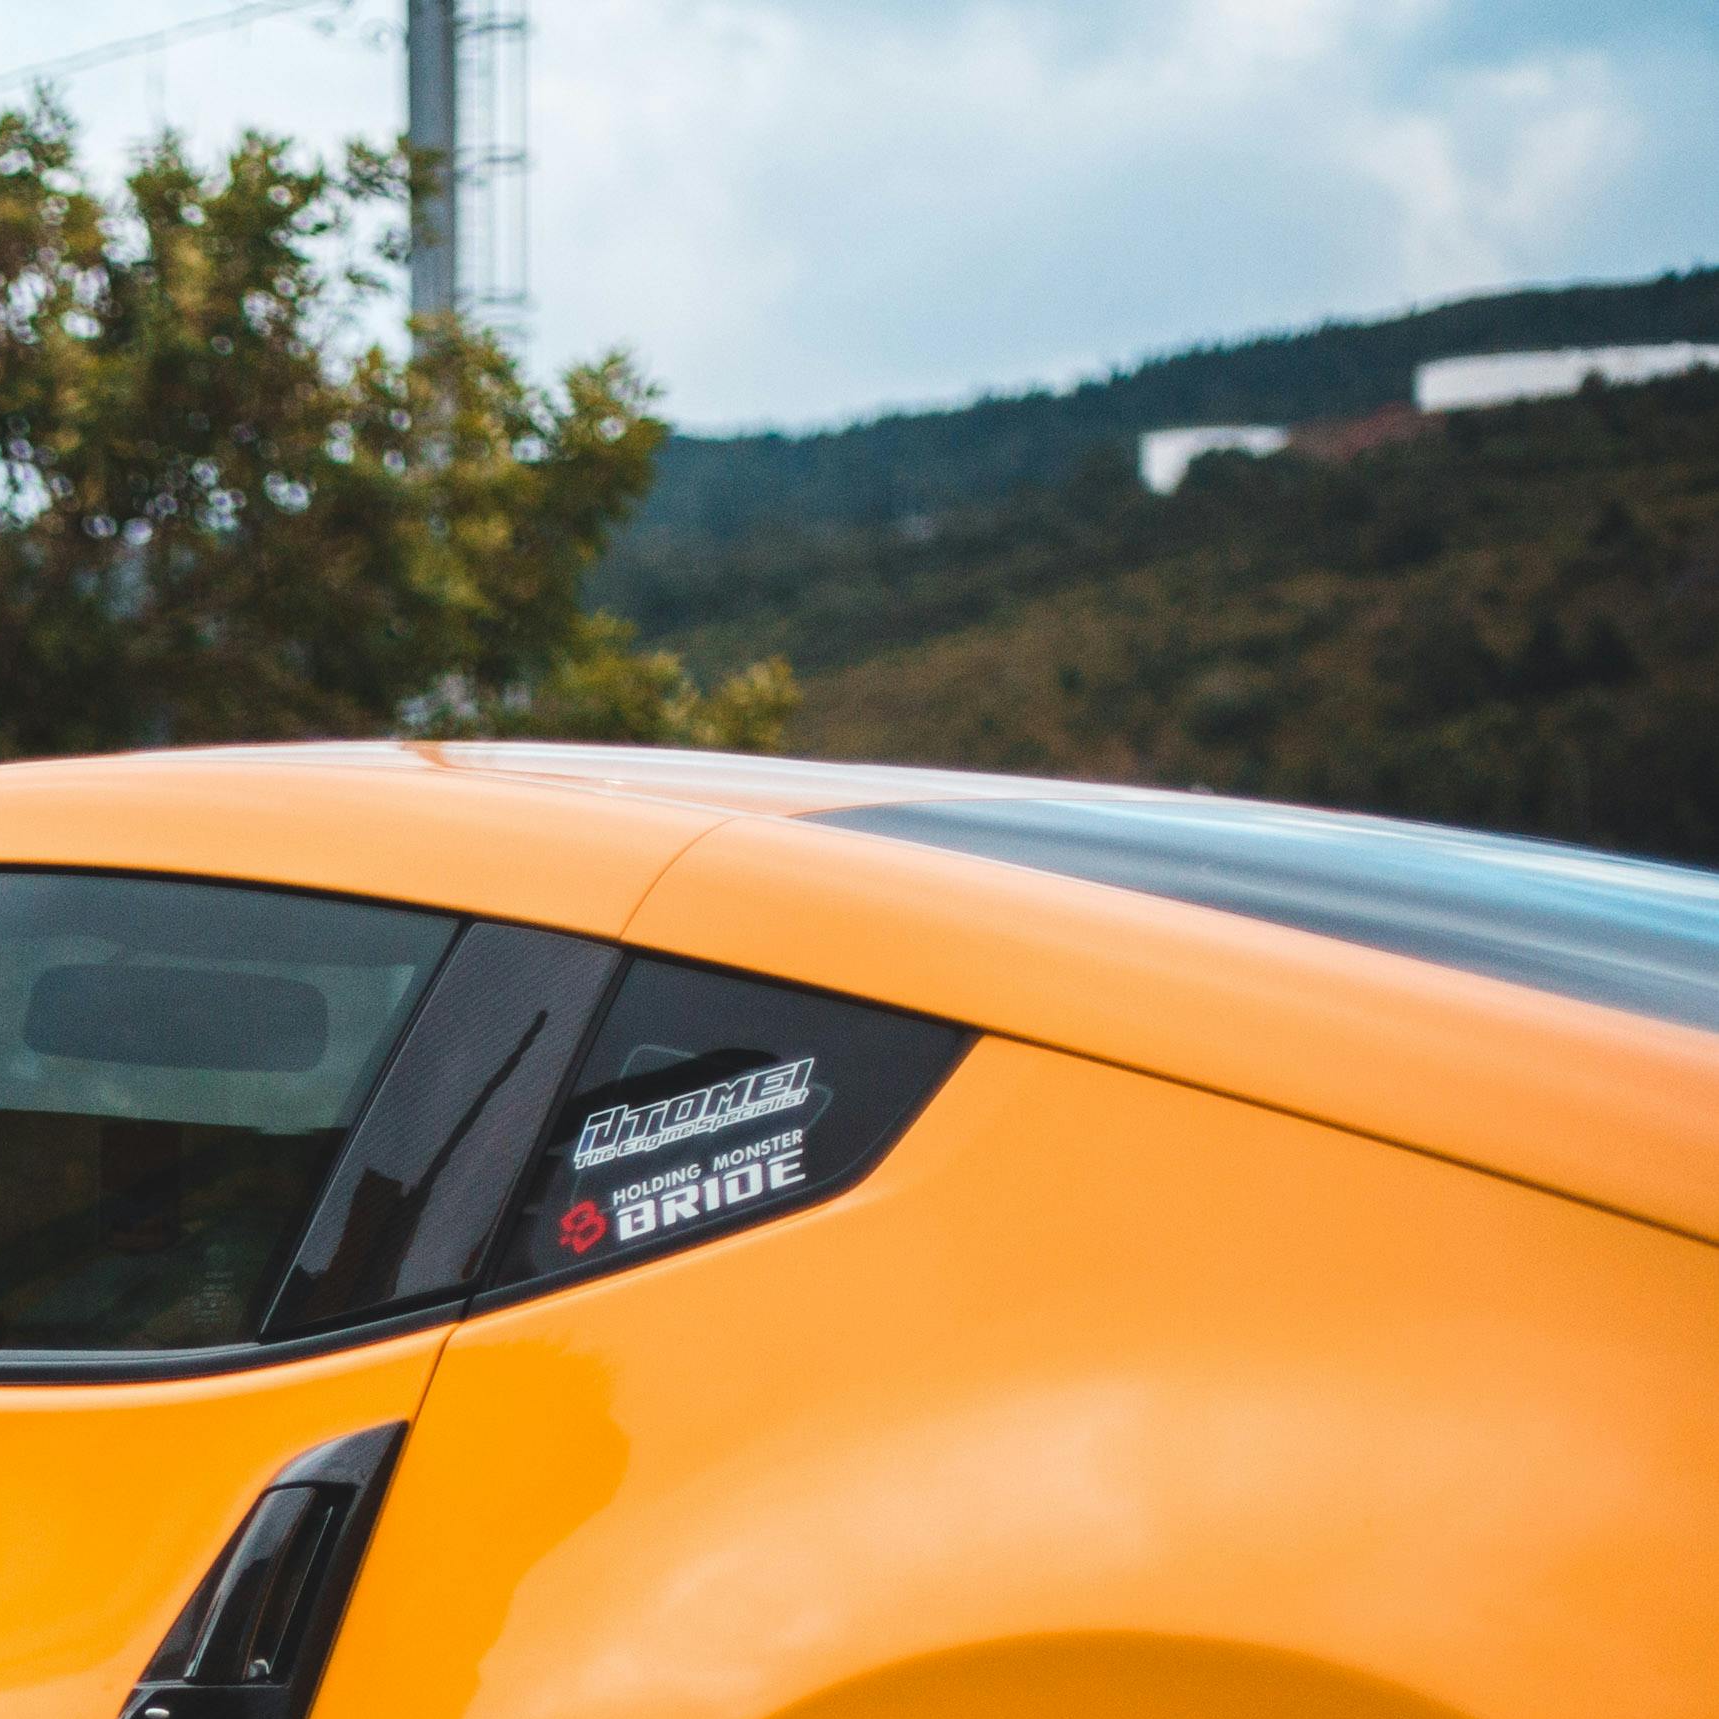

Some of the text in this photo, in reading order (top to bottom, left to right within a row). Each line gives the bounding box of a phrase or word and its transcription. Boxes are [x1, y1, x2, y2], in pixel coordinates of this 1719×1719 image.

[574, 1087, 809, 1169] The Engine Specialist
[624, 1058, 814, 1139] TOMEI
[613, 1128, 803, 1206] HOLDING MONSTER
[616, 1148, 806, 1241] BRIDE
